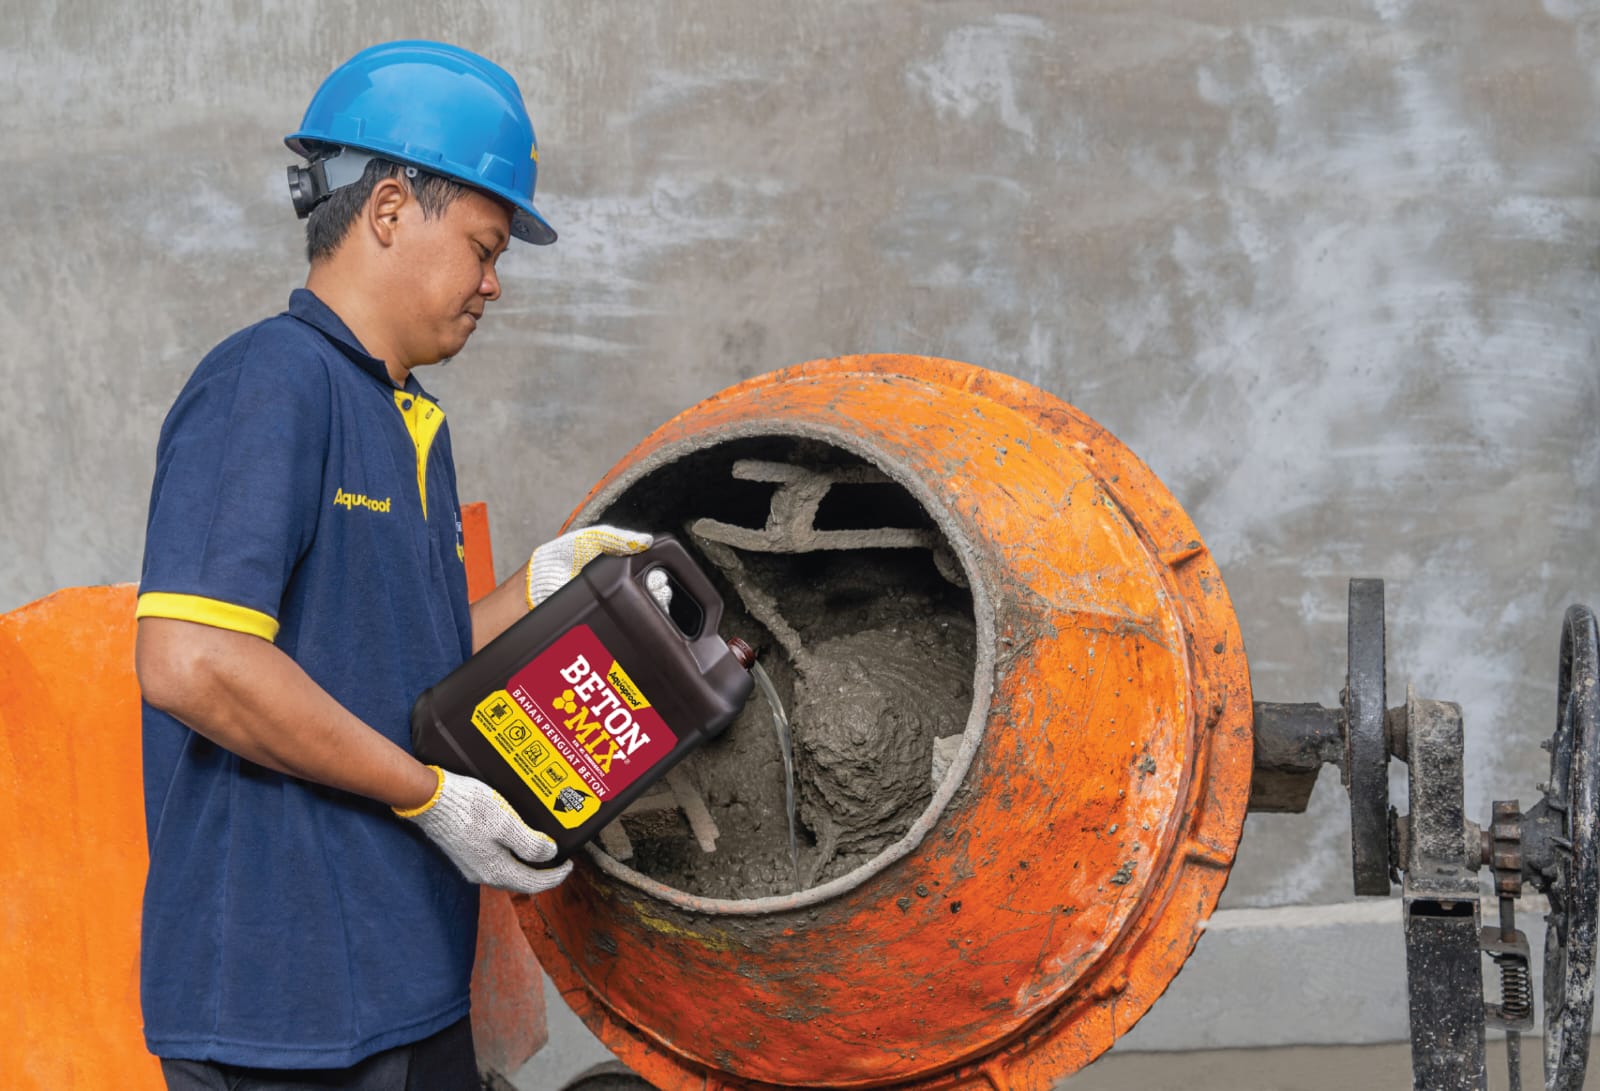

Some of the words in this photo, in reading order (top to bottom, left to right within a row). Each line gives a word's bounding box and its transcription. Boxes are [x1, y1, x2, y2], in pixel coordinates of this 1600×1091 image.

[334, 488, 391, 512] Aquaroof
[560, 654, 651, 756] BETON
[609, 671, 642, 707] Aquaproof
[512, 689, 544, 724] BAHAN
[541, 723, 581, 766] PENGUAT
[578, 766, 606, 797] BETON
[563, 705, 627, 774] MIX
